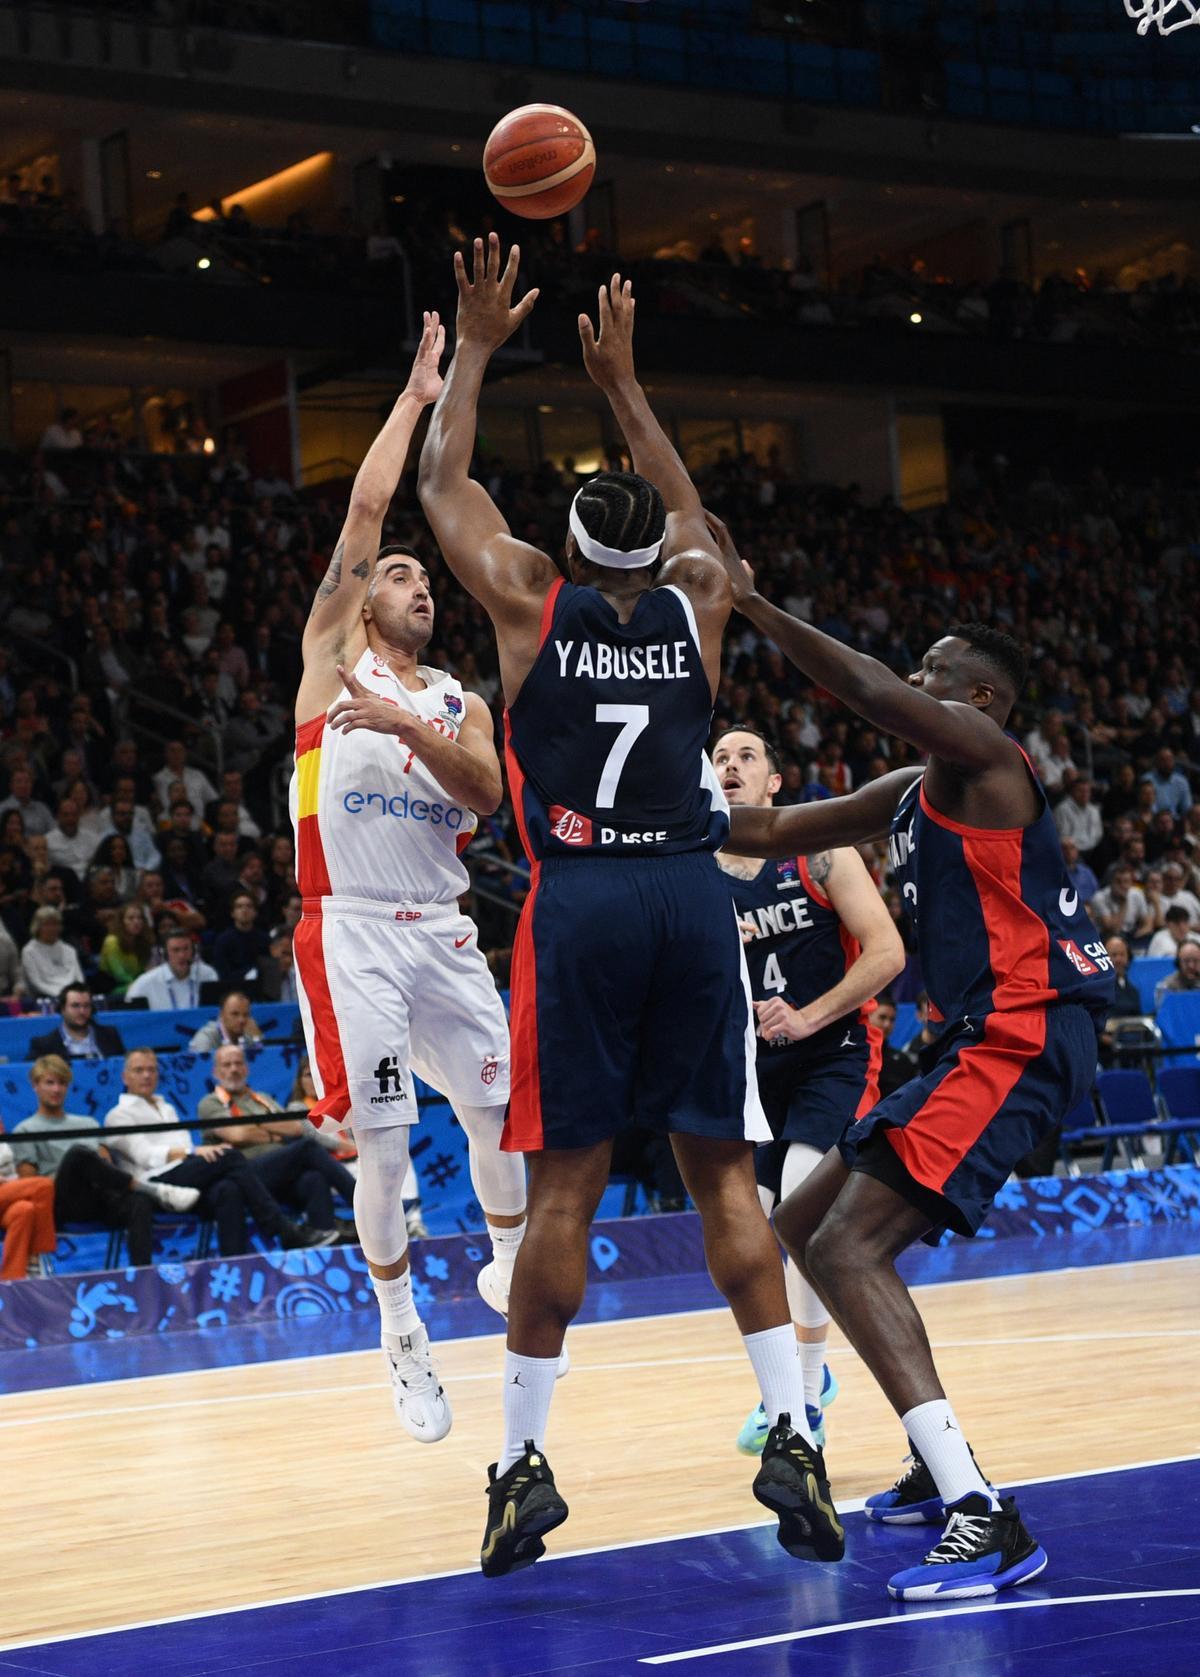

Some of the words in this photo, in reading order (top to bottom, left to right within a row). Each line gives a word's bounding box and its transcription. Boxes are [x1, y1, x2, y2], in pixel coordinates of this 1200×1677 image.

[509, 150, 558, 173] molten
[554, 640, 691, 680] YABUSELE
[595, 703, 650, 809] 7
[343, 791, 463, 830] endesa
[395, 911, 422, 921] ESP
[762, 953, 788, 994] 4
